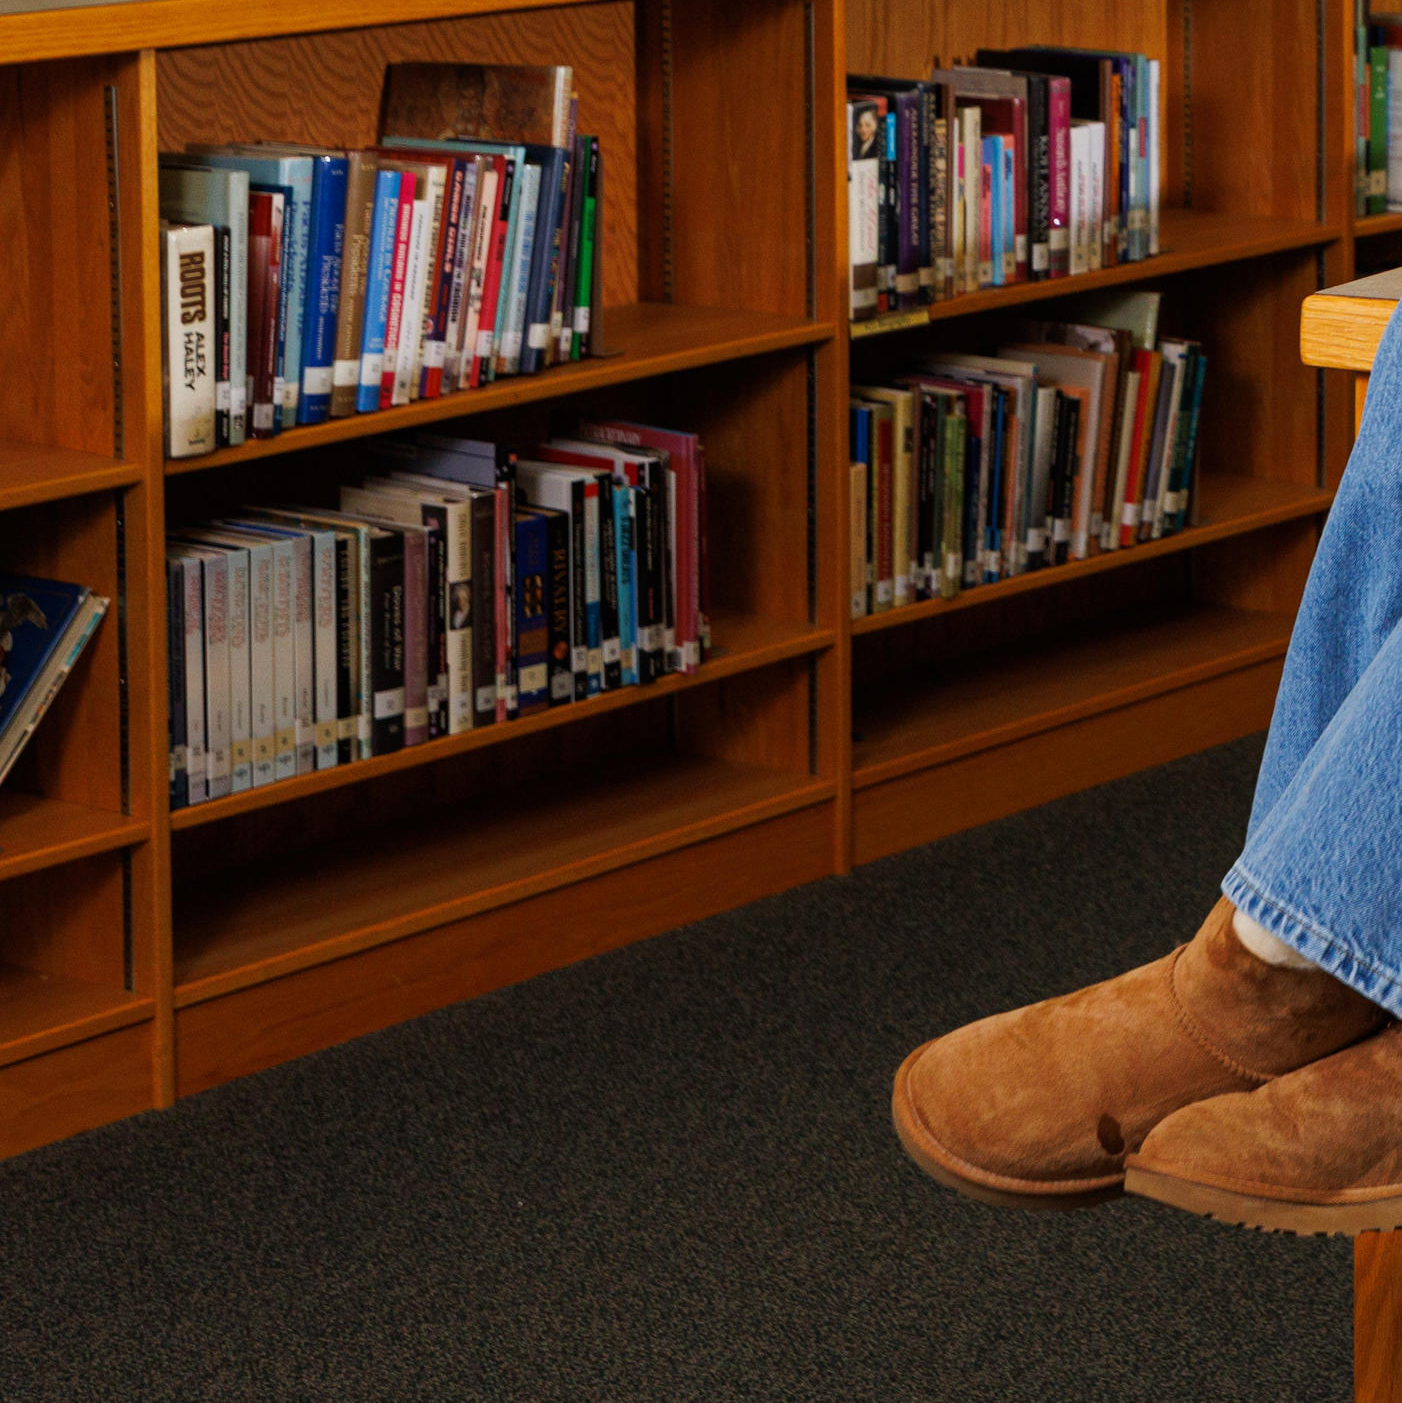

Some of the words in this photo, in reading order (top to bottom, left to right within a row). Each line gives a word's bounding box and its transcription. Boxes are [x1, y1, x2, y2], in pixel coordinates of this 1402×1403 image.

[180, 251, 206, 326] ROOTS
[184, 332, 196, 390] HALEY
[196, 332, 207, 378] ALEX
[552, 548, 568, 634] RIVALRY
